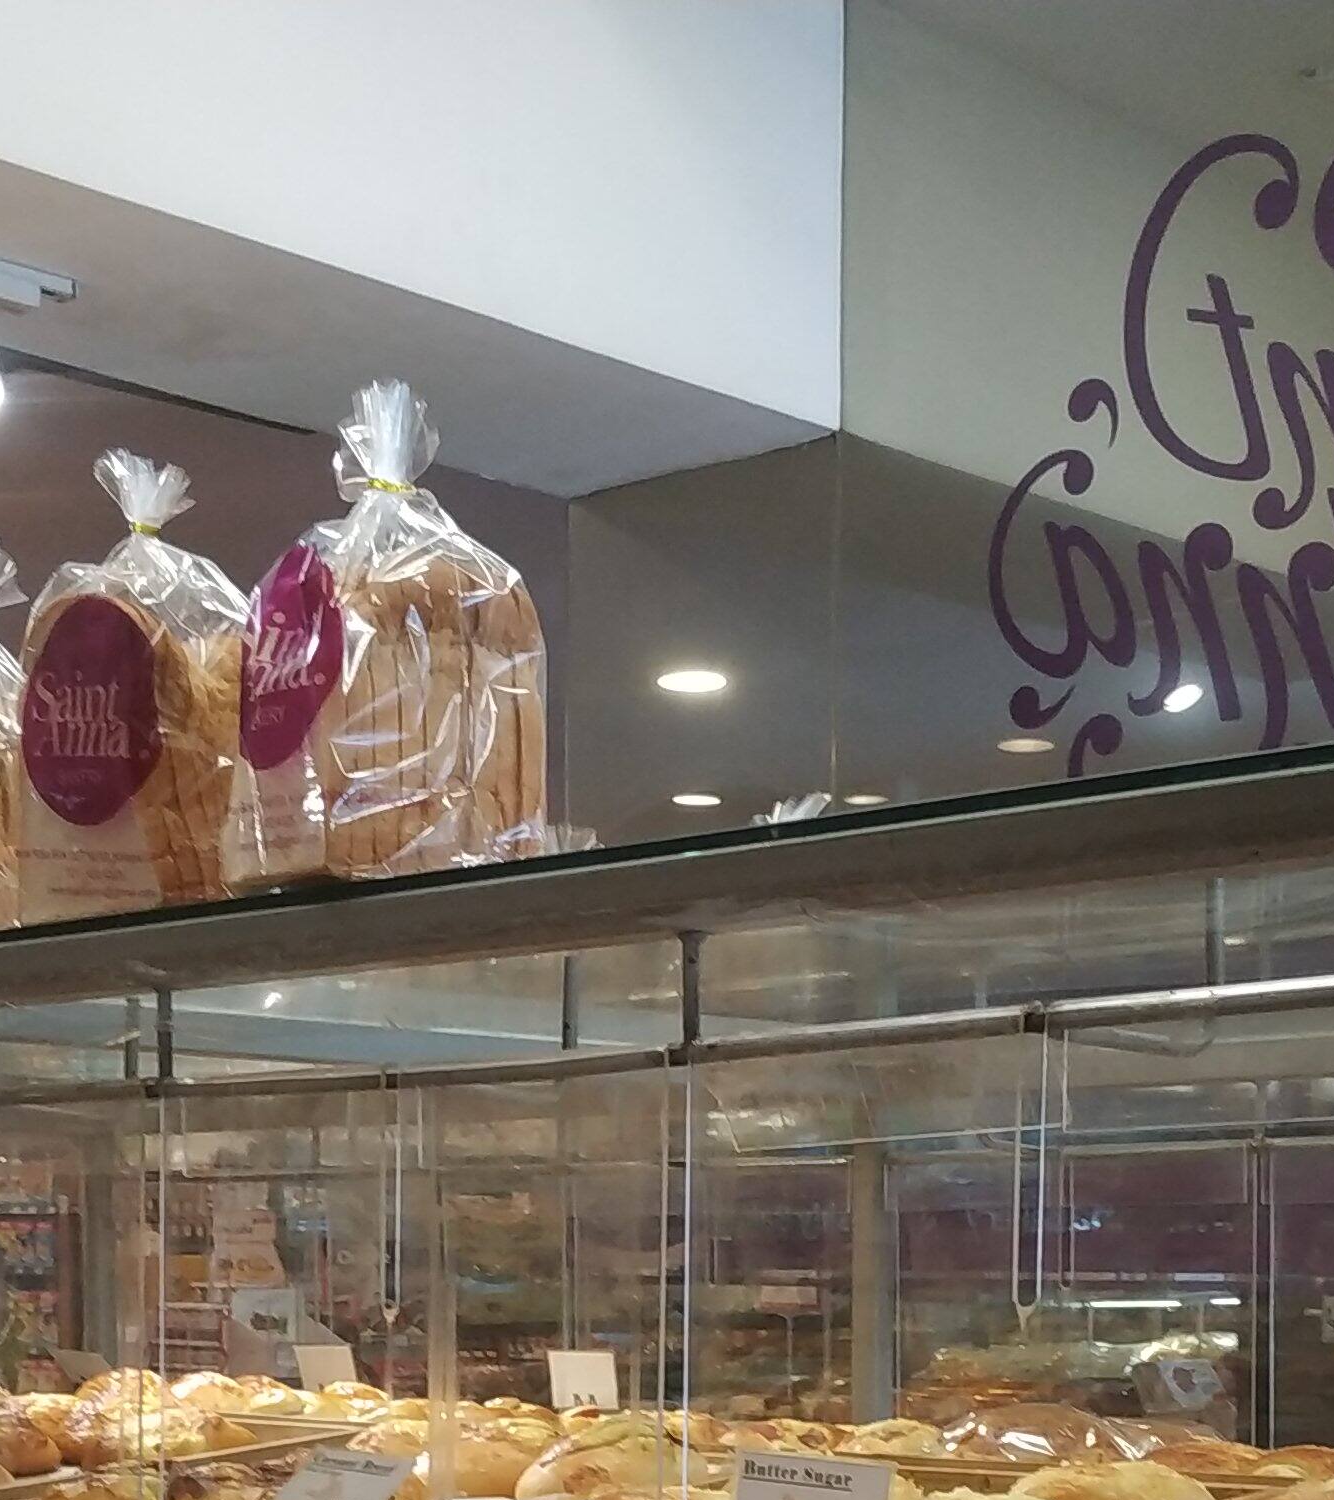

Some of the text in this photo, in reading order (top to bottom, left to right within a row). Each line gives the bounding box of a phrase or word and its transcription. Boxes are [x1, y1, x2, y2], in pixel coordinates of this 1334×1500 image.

[32, 670, 119, 725] Saint
[33, 720, 131, 759] Anna
[744, 1458, 853, 1488] Butter Sugar
